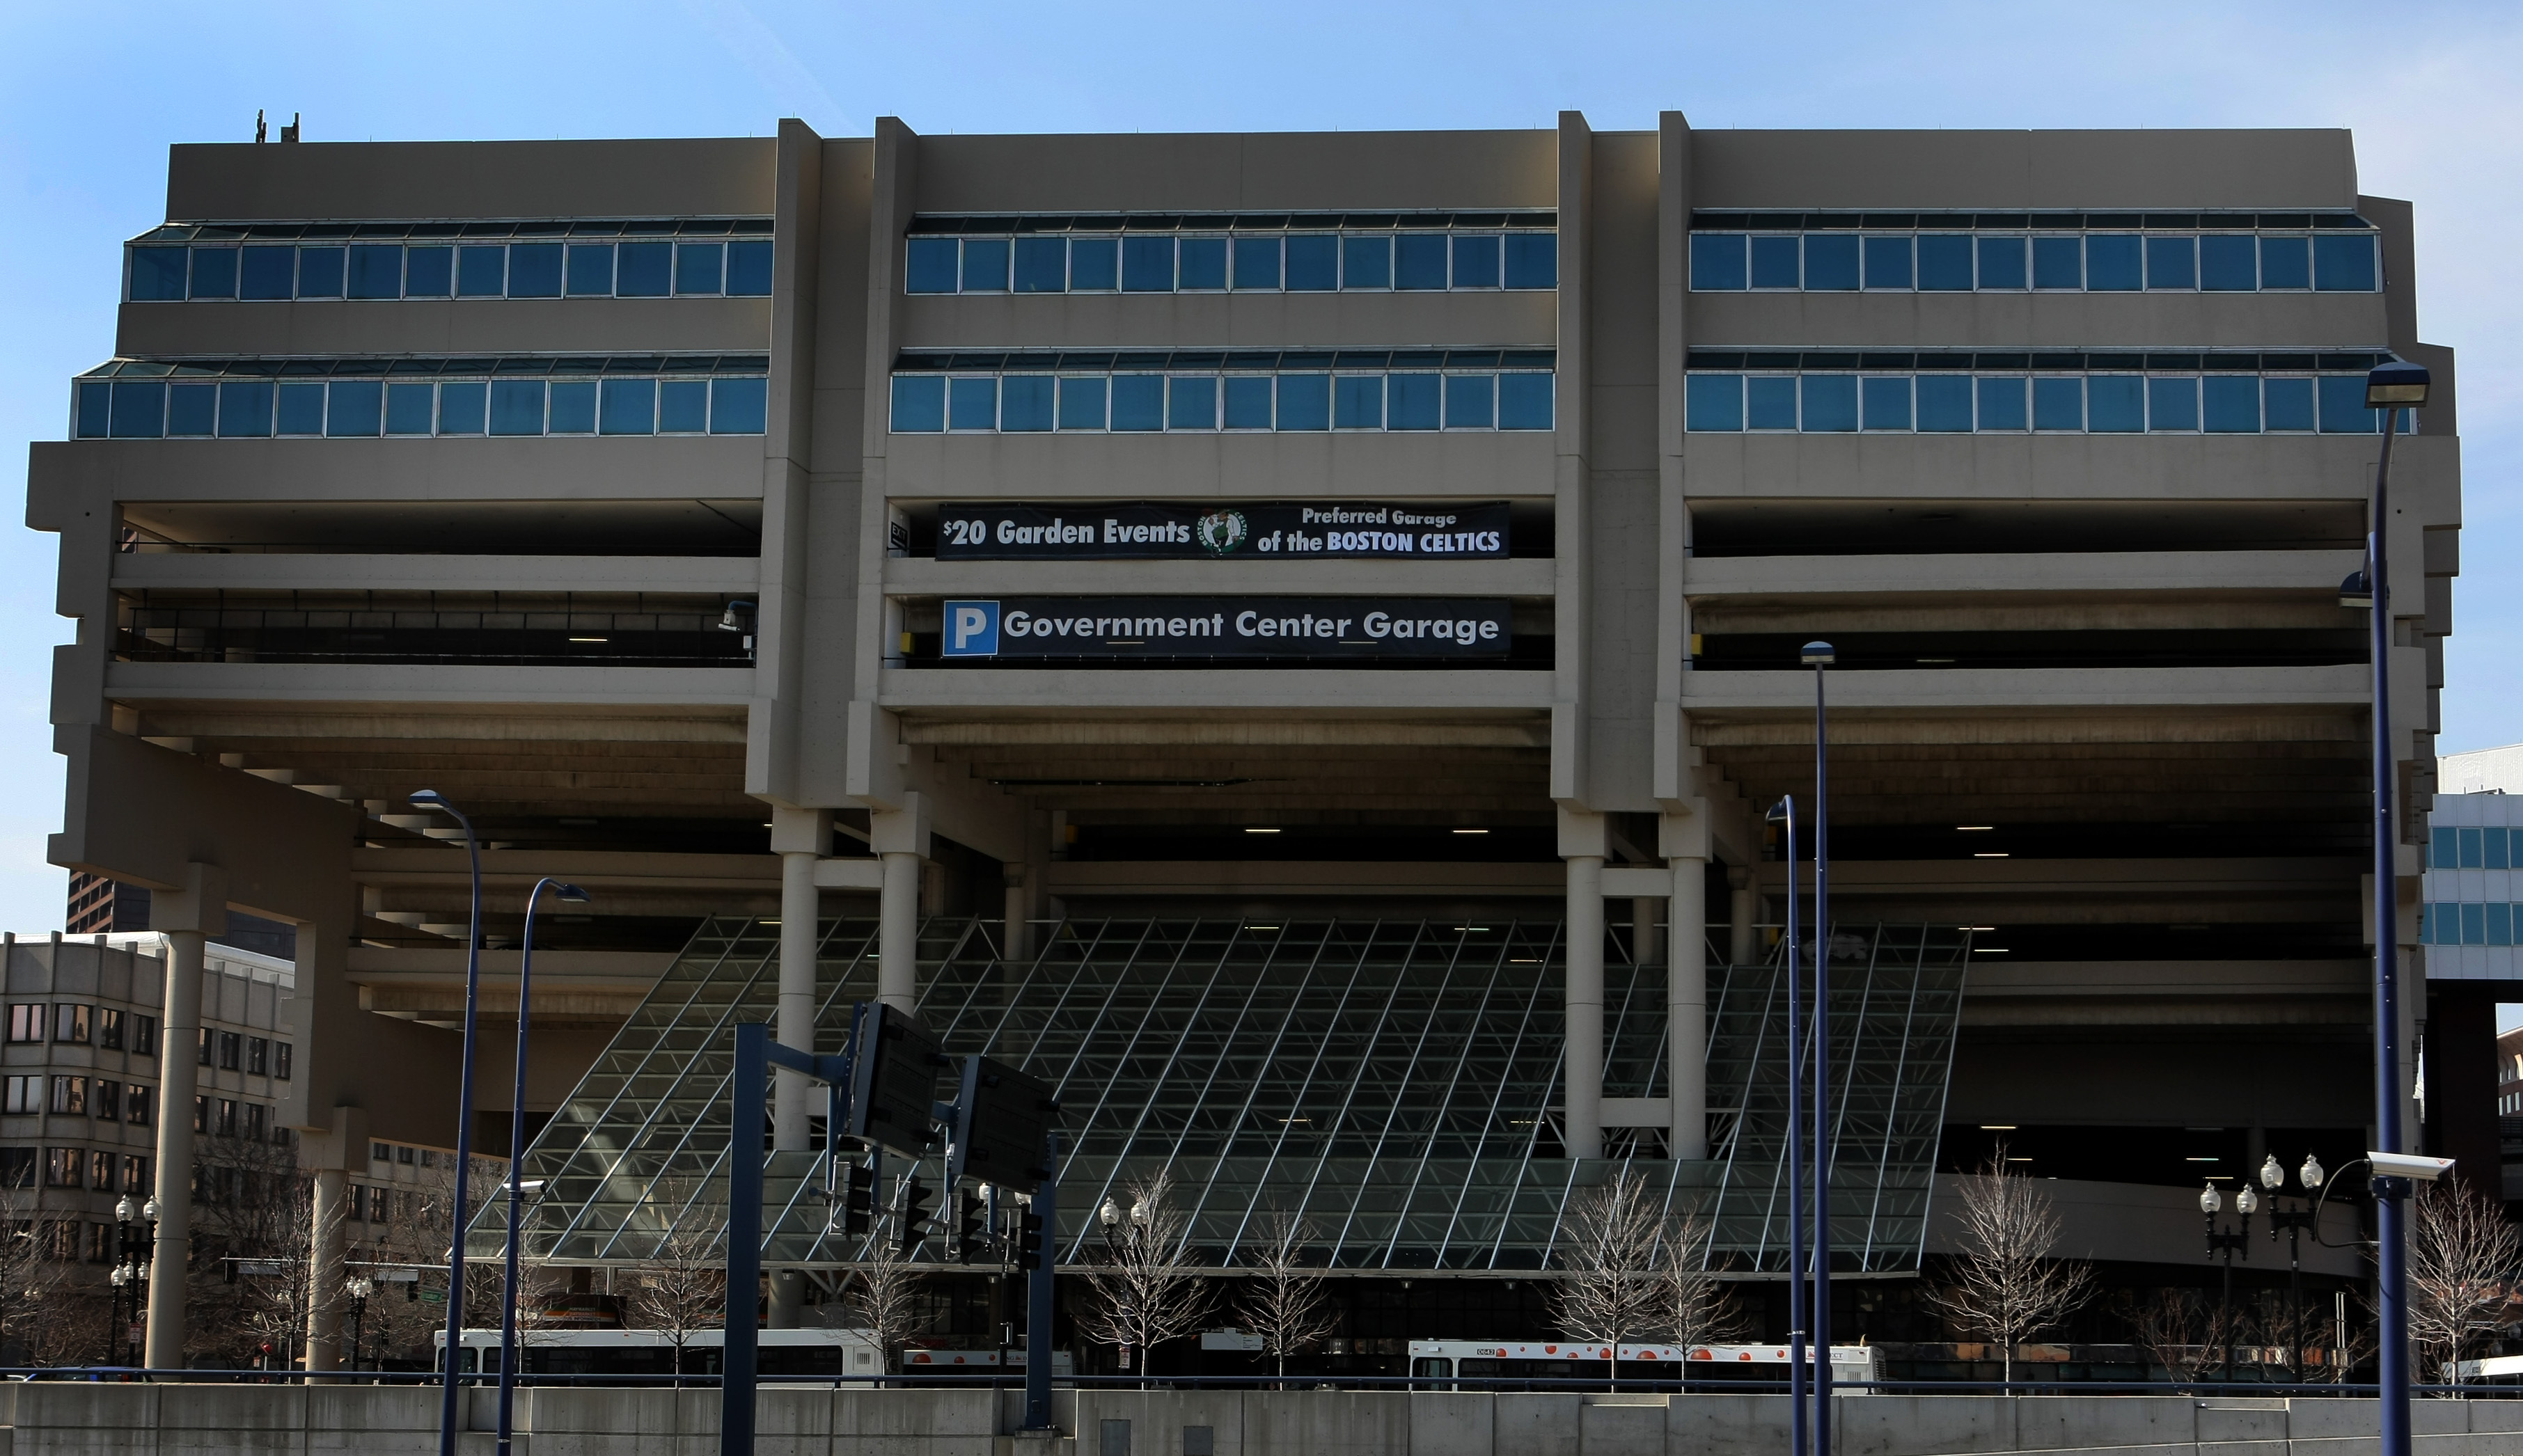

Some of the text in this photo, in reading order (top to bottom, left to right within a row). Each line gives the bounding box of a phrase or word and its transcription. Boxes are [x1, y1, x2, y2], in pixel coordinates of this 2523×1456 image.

[943, 518, 1190, 545] $20 Garden Events
[1197, 516, 1208, 546] BOSTON
[1234, 512, 1247, 540] CELTICS
[1302, 507, 1456, 528] Preferred Garage
[1258, 530, 1500, 552] of the BOSTON CELTICS
[955, 608, 987, 649] P
[1005, 610, 1499, 645] Government Center Garage
